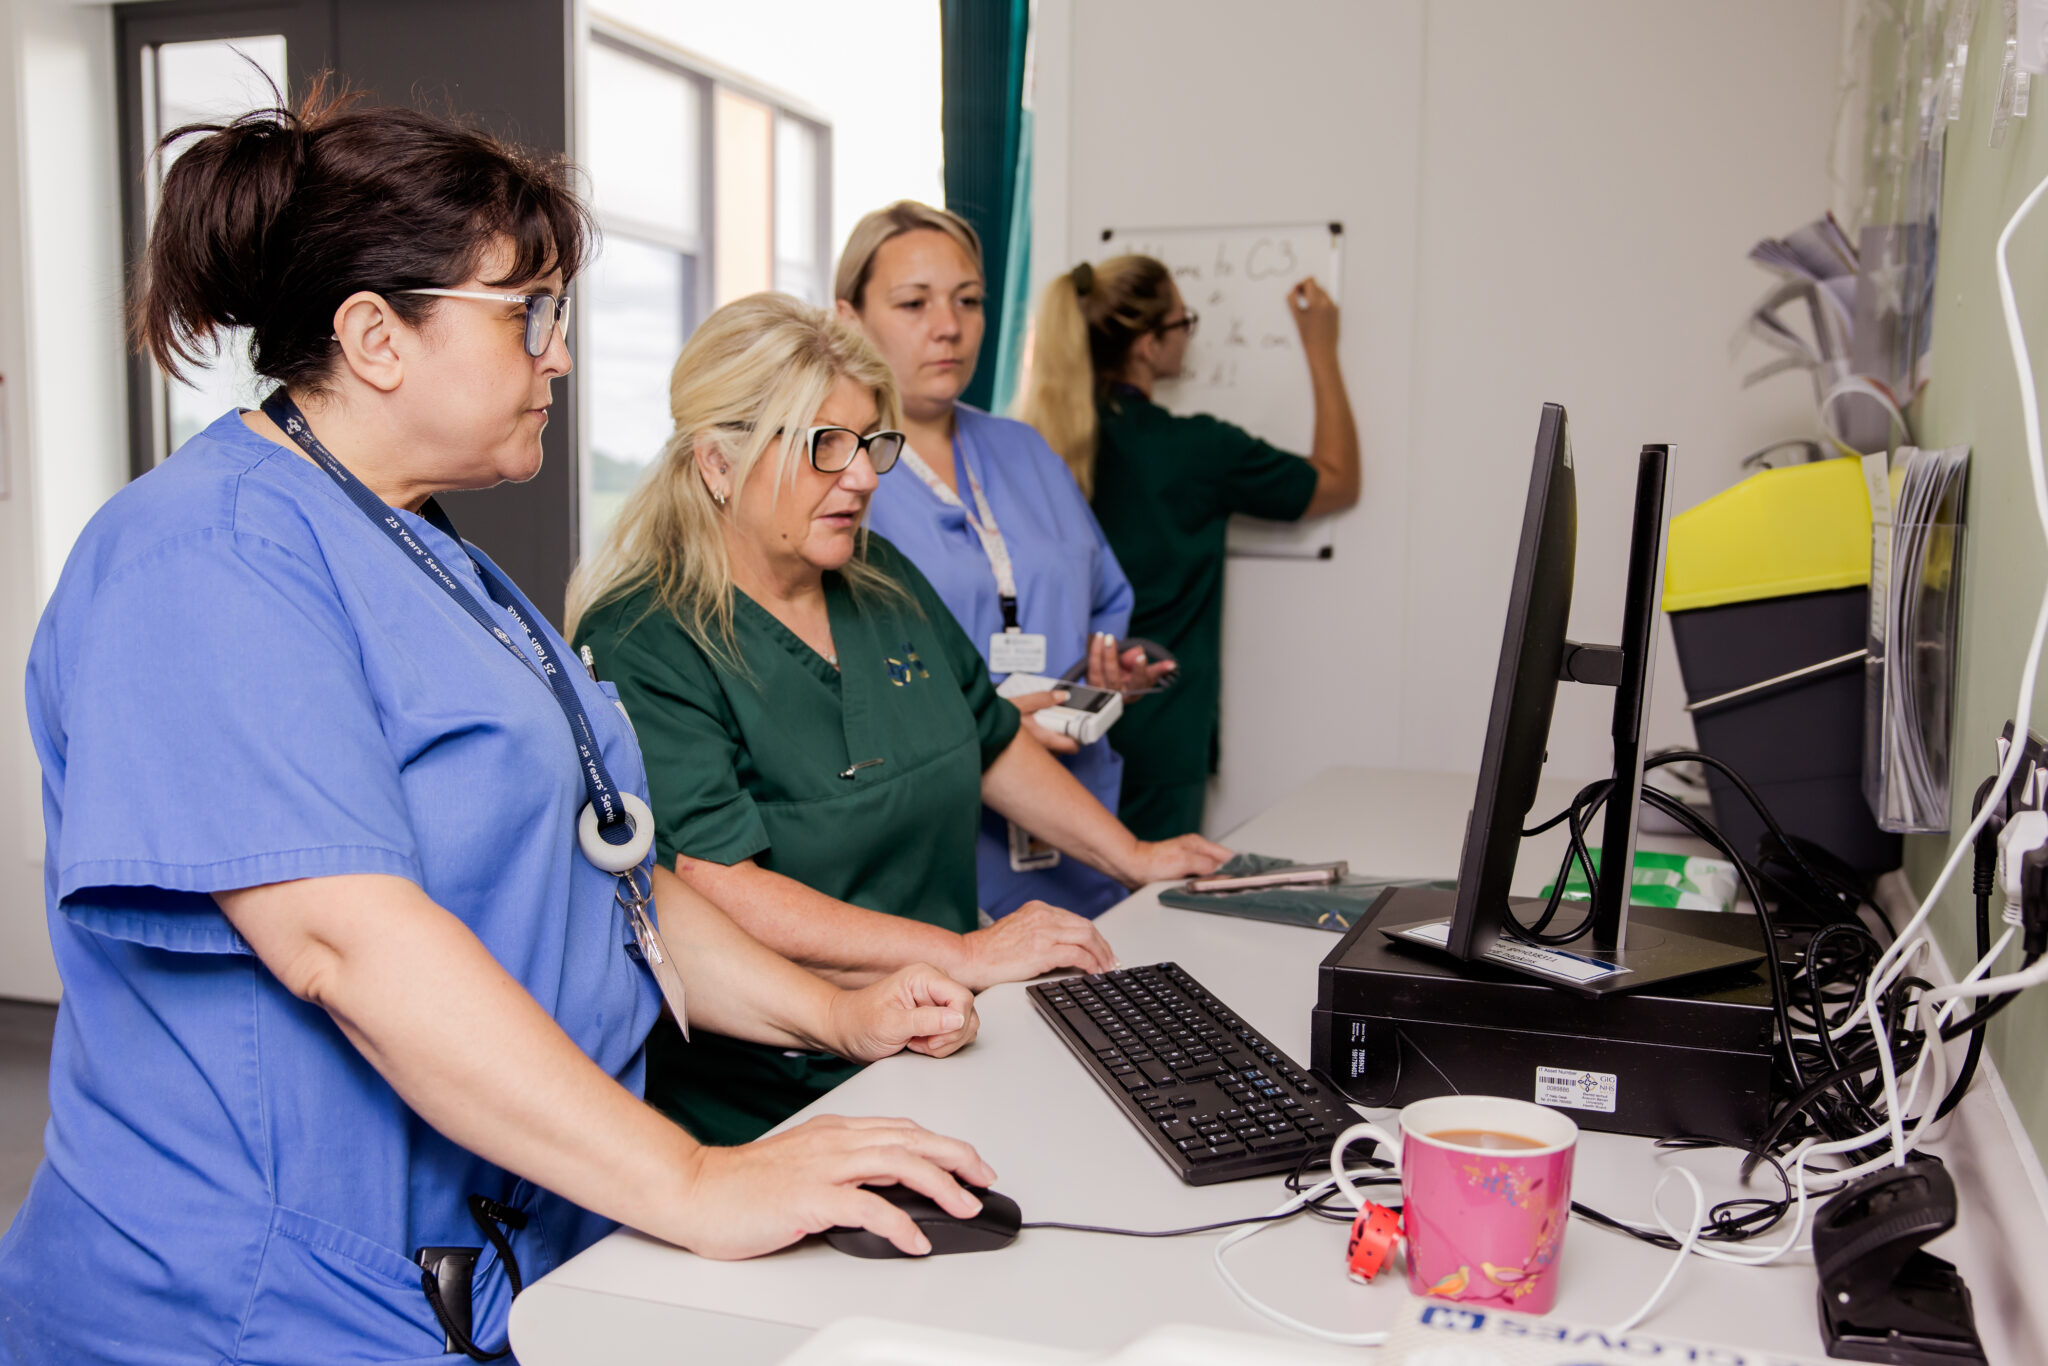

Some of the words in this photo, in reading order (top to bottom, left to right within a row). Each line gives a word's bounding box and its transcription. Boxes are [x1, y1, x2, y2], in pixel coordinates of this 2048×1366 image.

[385, 515, 400, 529] 25
[399, 528, 428, 555] Years'
[425, 557, 457, 590] Service
[543, 662, 557, 675] 25
[580, 744, 591, 758] 25
[587, 759, 608, 791] Years'
[600, 793, 617, 823] Servic
